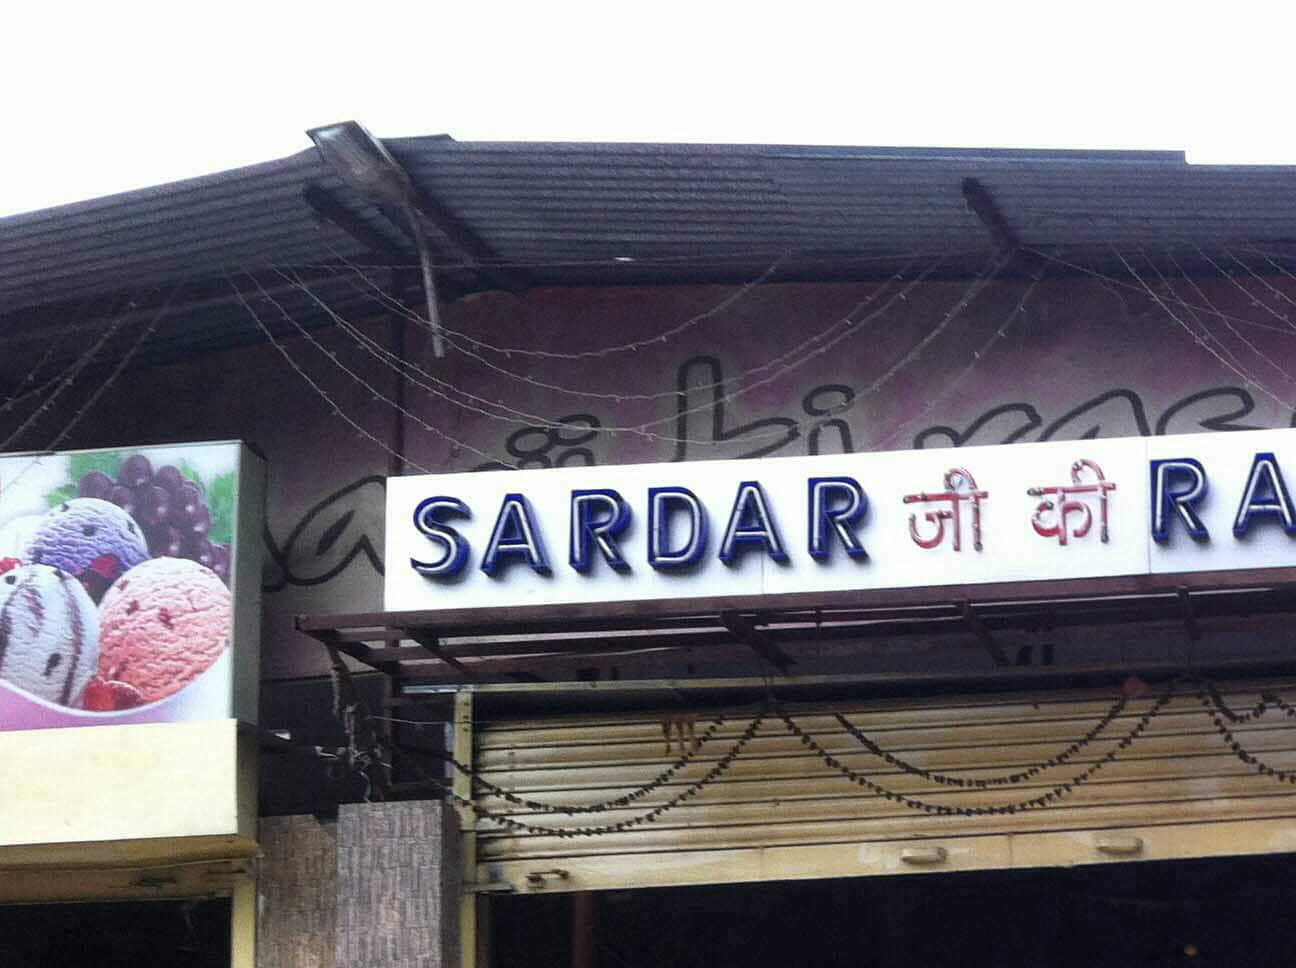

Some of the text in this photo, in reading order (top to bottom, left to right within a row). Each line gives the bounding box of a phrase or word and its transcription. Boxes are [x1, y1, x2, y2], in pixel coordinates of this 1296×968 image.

[410, 475, 870, 578] SARDAR
[902, 465, 989, 552] जी
[1026, 457, 1117, 545] की
